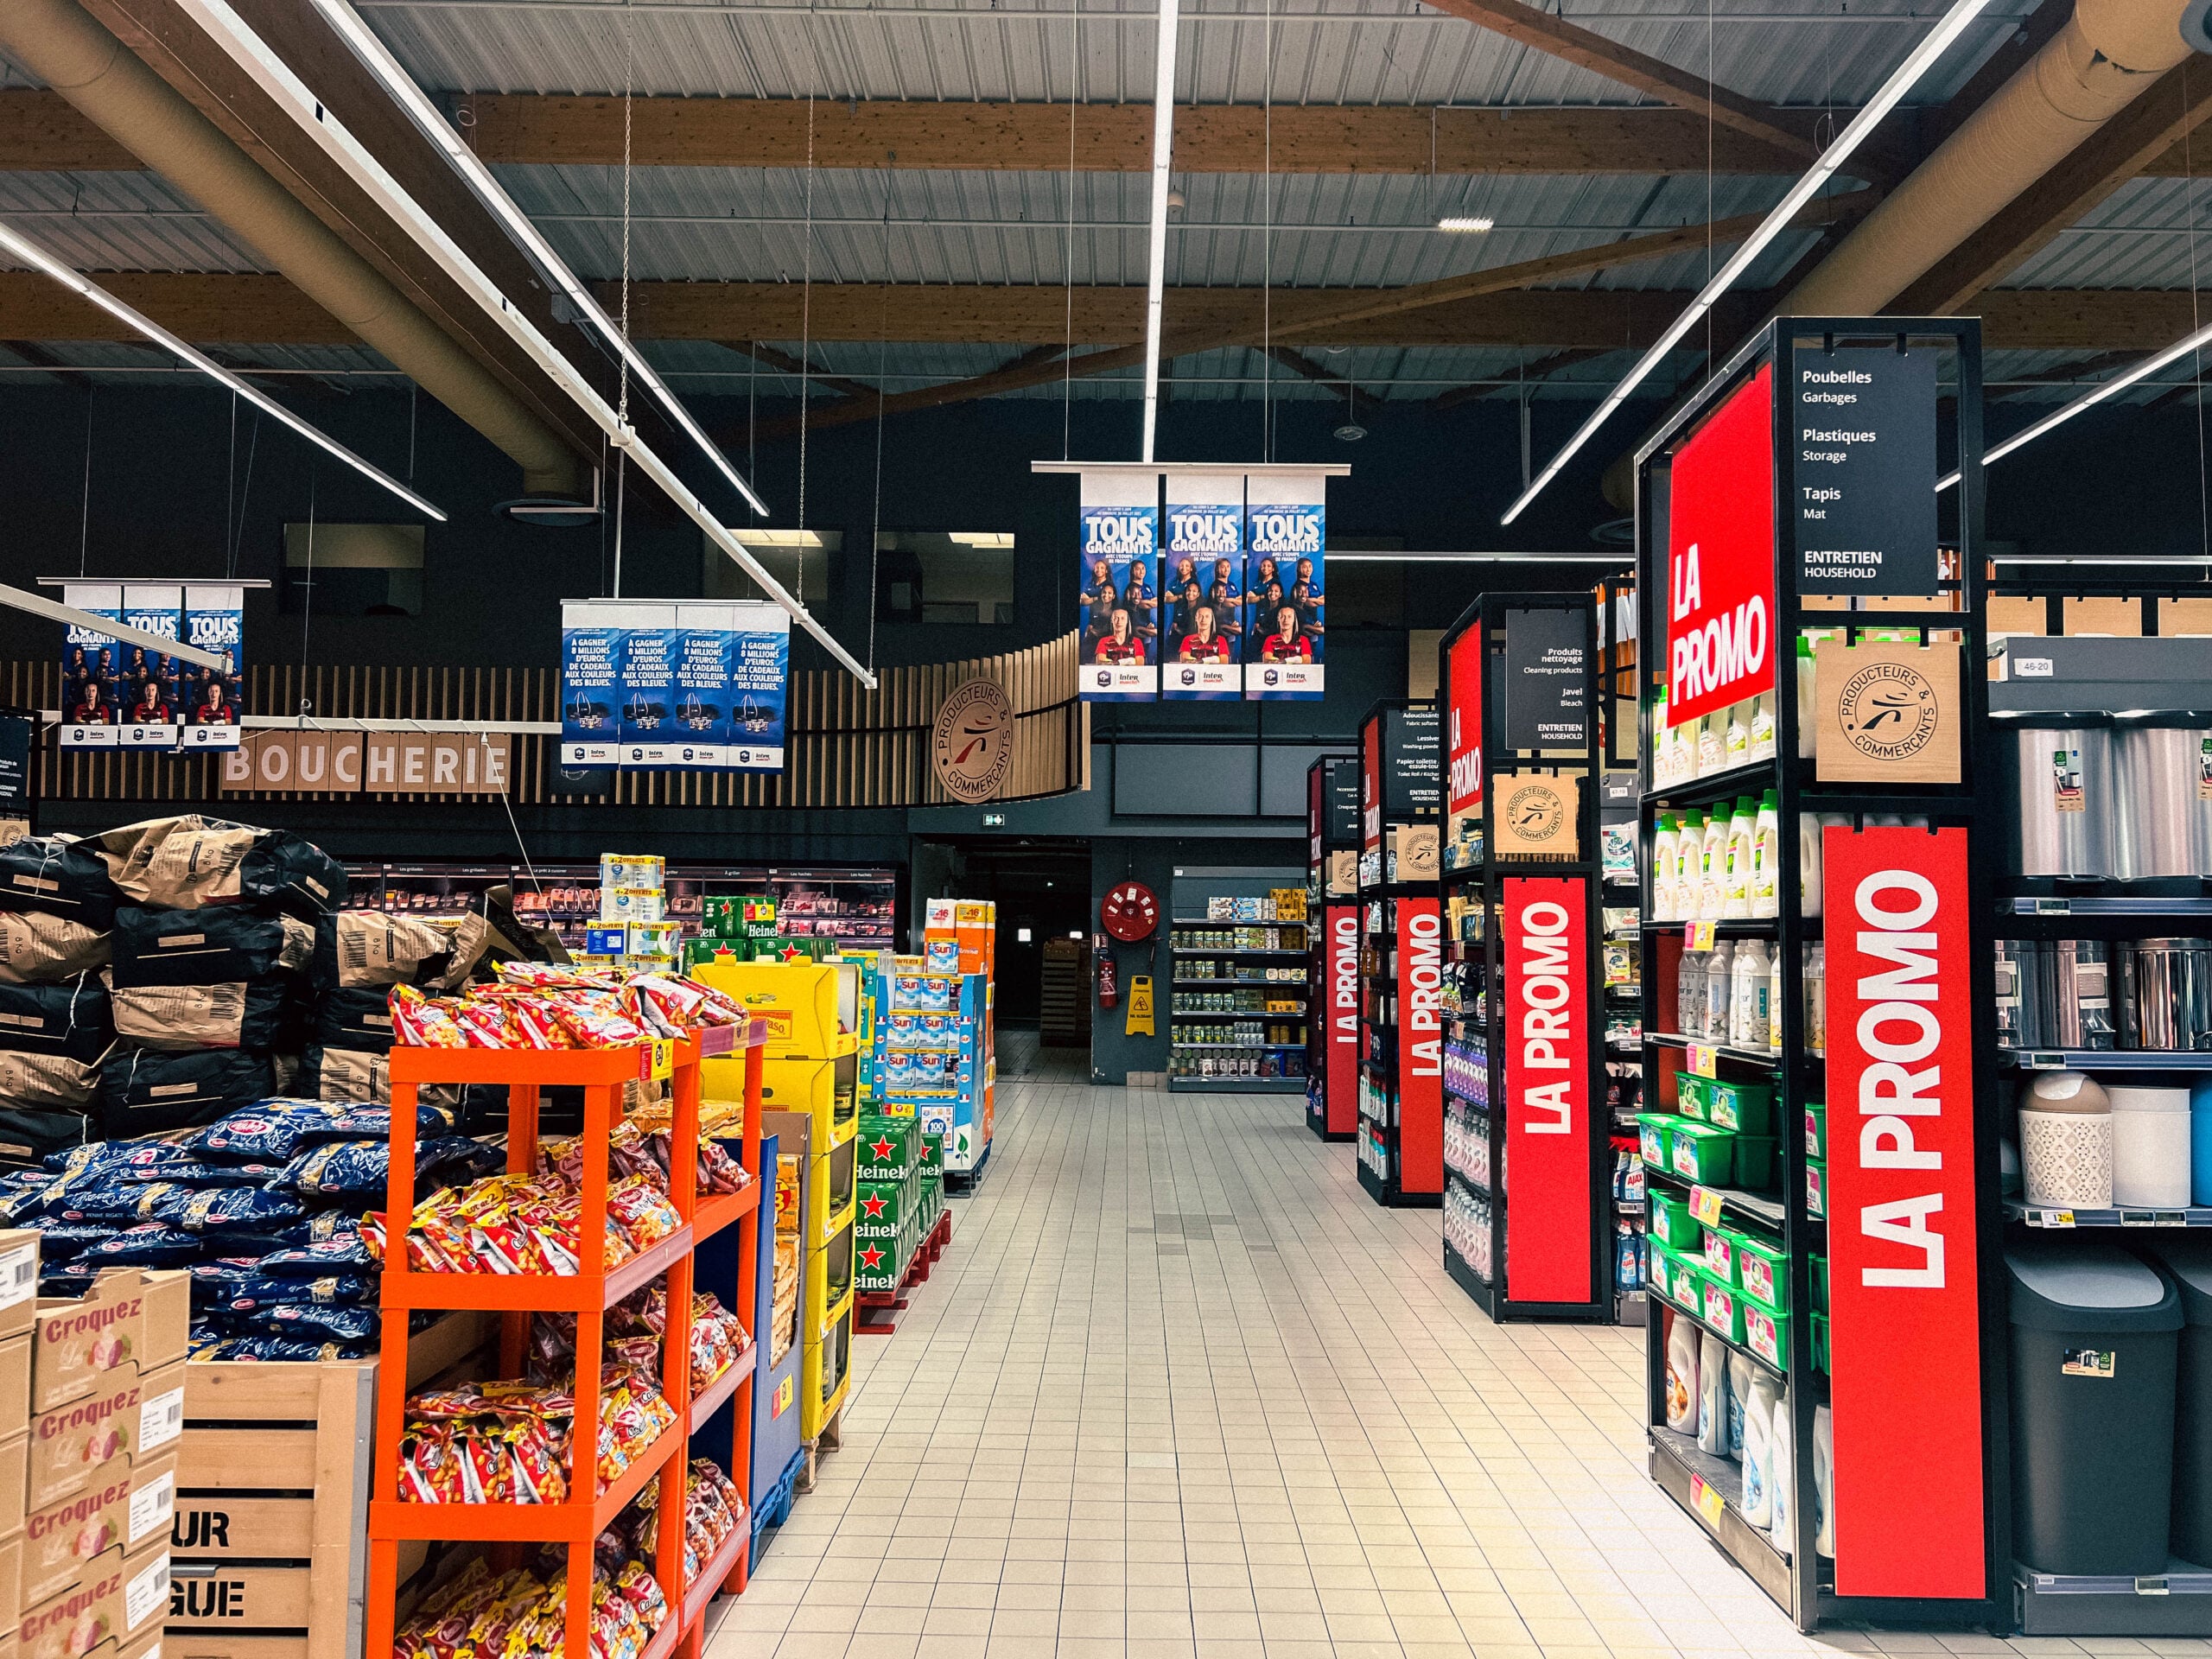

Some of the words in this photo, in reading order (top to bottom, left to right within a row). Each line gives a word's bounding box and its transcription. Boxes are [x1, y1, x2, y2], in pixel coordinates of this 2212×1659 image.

[1802, 371, 1872, 384] Poubelles
[1802, 392, 1857, 405] Garbages
[1802, 429, 1877, 445] Plastiques
[1802, 451, 1847, 464] Storage
[1802, 487, 1841, 503] Tapis
[1171, 515, 1237, 540] TOUS
[1252, 515, 1319, 540] TOUS
[1803, 509, 1826, 519] Mat
[1086, 517, 1153, 542] TOUS
[1086, 541, 1153, 555] GAGNANTS
[1171, 539, 1237, 553] GAGNANTS
[1252, 539, 1319, 553] GAGNANTS
[1804, 550, 1882, 564] ENTRETIEN
[1674, 543, 1701, 623] LA
[1804, 567, 1877, 578] HOUSEHOLD
[189, 617, 238, 637] TOUS
[572, 638, 577, 646] À
[628, 639, 634, 647] À
[1672, 594, 1766, 707] PROMO
[1562, 688, 1583, 696] Javel
[1842, 666, 1919, 715] PRODUCTEURS
[1918, 690, 1929, 700] &
[938, 685, 1001, 749] PRODUCTEURS
[1000, 709, 1008, 721] &
[1452, 707, 1461, 752] LA
[1854, 708, 1935, 757] COMMERÇANTS
[226, 745, 506, 784] BOUCHERIE
[948, 729, 1011, 795] COMMERÇANTS
[1452, 746, 1481, 803] PROMO
[1509, 787, 1553, 817] PRODUCTEURS
[1516, 810, 1561, 840] COMMERÇANTS
[748, 925, 779, 938] Heinek
[1335, 917, 1357, 1007] PROMO
[1408, 913, 1441, 1031] PROMO
[1521, 901, 1570, 1069] PROMO
[1854, 869, 1942, 1170] PROMO
[1412, 1039, 1441, 1076] LA
[1524, 1080, 1571, 1135] LA
[1628, 1173, 1643, 1185] AJAX
[1860, 1192, 1946, 1288] LA
[46, 1298, 142, 1343] Croquez
[39, 1388, 140, 1440] Croquez
[29, 1479, 130, 1541] Croquez
[20, 1573, 122, 1643] Croquez
